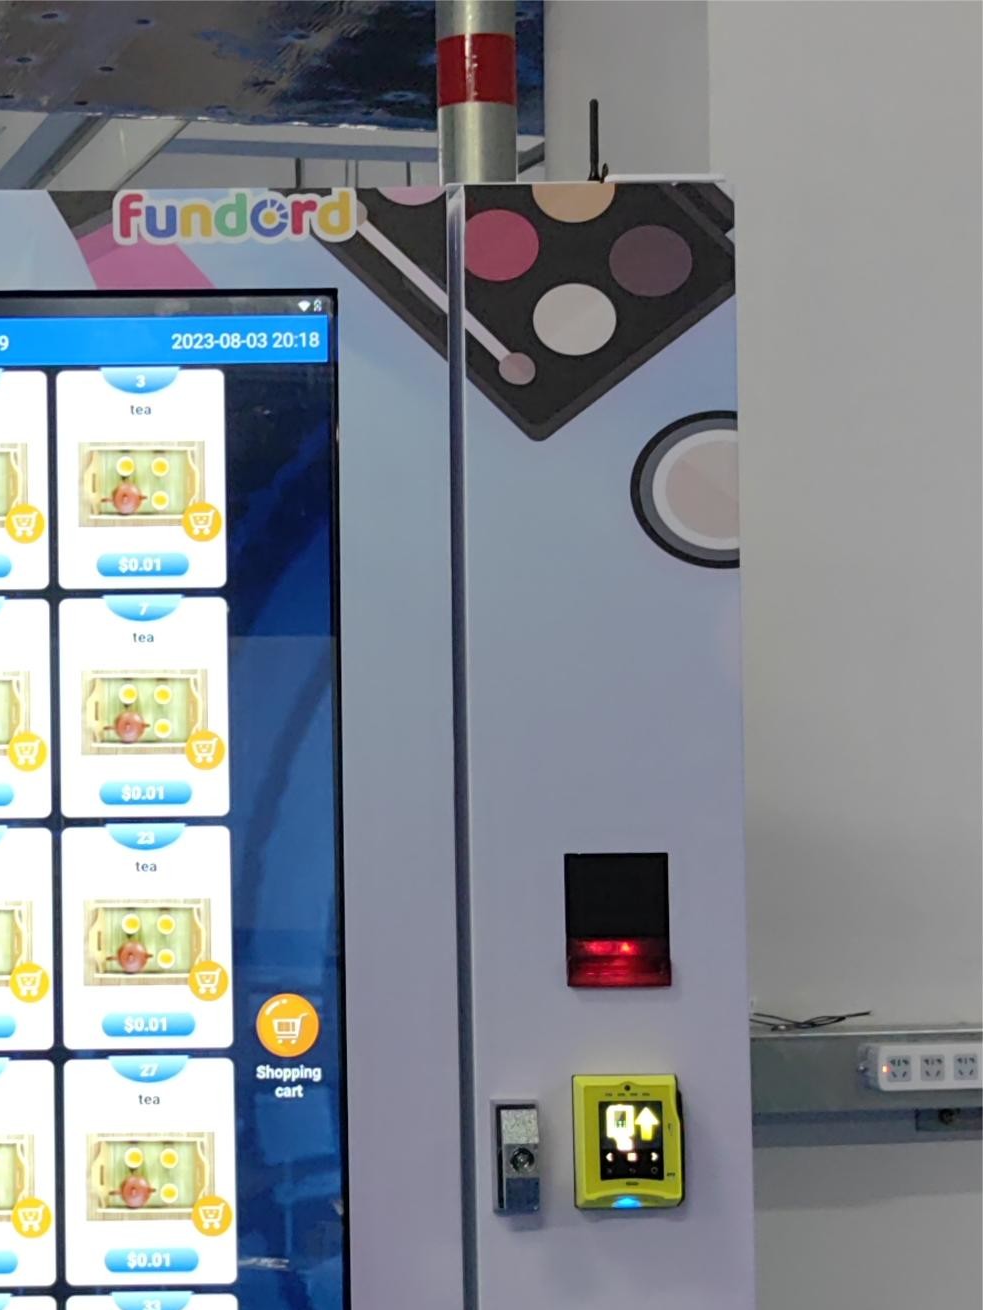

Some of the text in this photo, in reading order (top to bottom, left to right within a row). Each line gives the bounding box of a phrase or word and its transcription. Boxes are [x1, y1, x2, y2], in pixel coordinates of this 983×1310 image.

[171, 332, 320, 349] 2023-08-03 20:18
[136, 375, 146, 388] 3
[131, 405, 151, 416] tea
[119, 556, 161, 573] $0.01
[139, 603, 149, 616] 7
[133, 632, 154, 643] tea
[122, 784, 164, 801] $0.01
[137, 832, 155, 845] 23
[136, 861, 156, 872] tea
[124, 1016, 167, 1033] $0.01
[140, 1064, 158, 1077] 27
[256, 1065, 322, 1082] Shopping
[275, 1084, 304, 1098] cart
[139, 1094, 160, 1105] tea
[128, 1252, 170, 1268] $0.01
